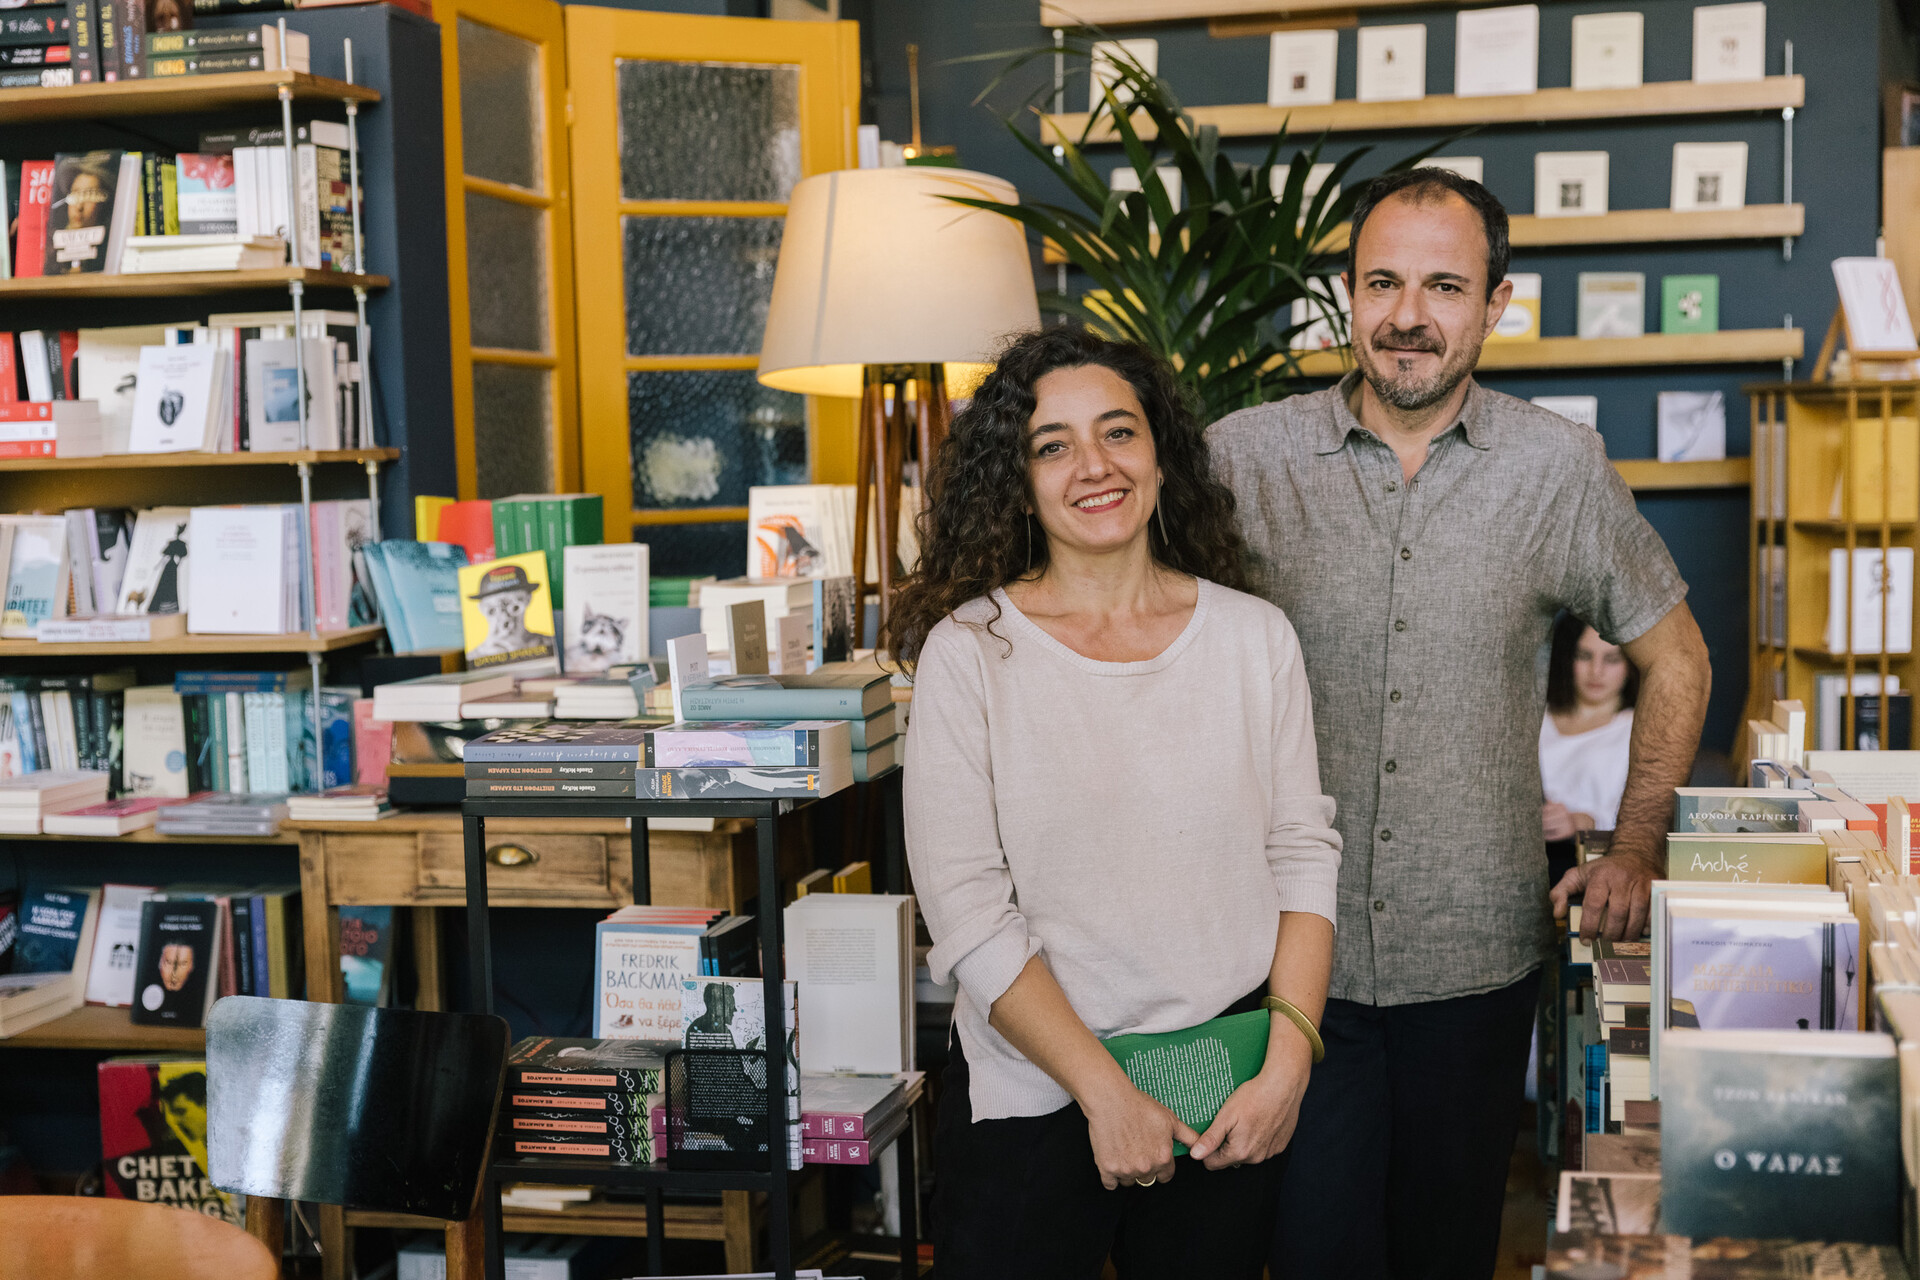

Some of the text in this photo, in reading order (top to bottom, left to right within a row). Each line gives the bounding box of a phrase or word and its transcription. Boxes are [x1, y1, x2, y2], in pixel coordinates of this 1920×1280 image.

[559, 766, 577, 774] McKay
[562, 784, 596, 792] Claude McKay
[1688, 812, 1737, 820] ΛΕΟΝΟΡΑ
[1690, 851, 1749, 873] André
[621, 953, 680, 970] FREDRIK
[1693, 963, 1774, 977] ΜΑΣΣΑΛΙΑ
[605, 992, 634, 1008] Όσα
[638, 998, 653, 1009] θα
[638, 1018, 653, 1027] να
[117, 1155, 196, 1179] CHET
[1714, 1148, 1844, 1176] Ο ΨΑΡΑΣ
